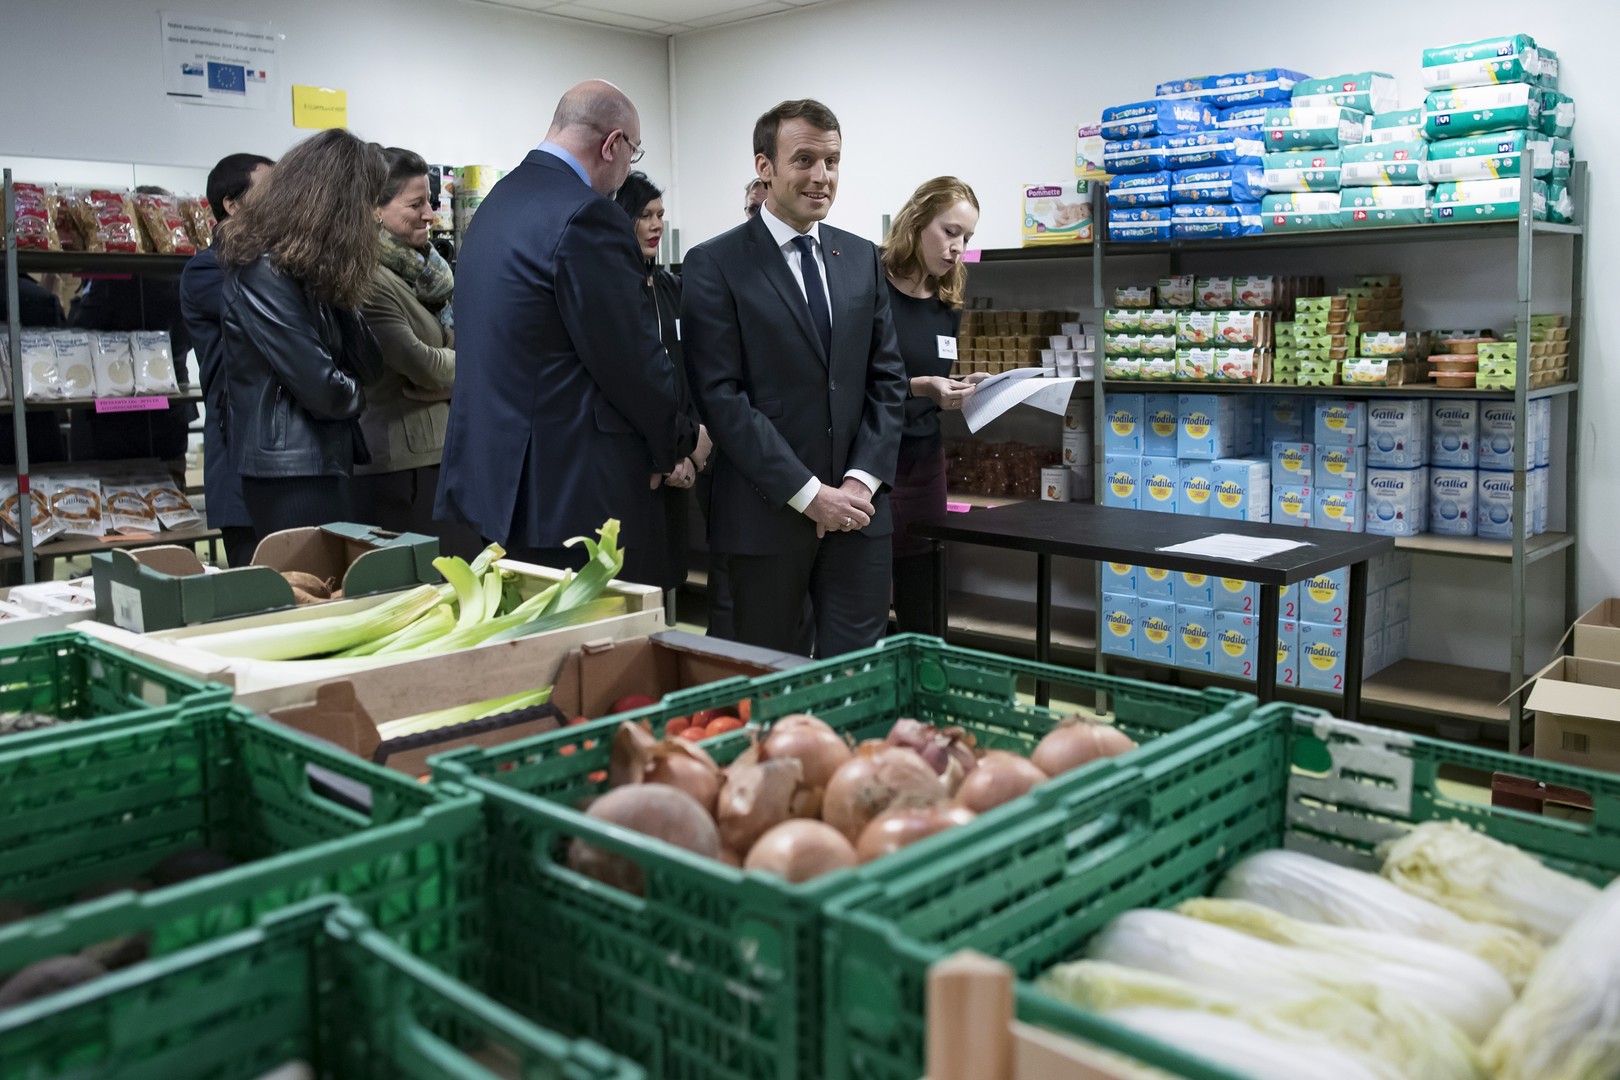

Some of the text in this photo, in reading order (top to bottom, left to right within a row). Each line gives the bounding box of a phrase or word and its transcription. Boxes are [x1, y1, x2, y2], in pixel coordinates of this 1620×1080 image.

[1078, 180, 1086, 189] 2
[1027, 189, 1061, 197] Pommette
[1107, 413, 1138, 424] modilac
[1148, 413, 1178, 424] modila
[1321, 409, 1351, 419] modilac
[1371, 407, 1405, 420] Gallia
[1435, 407, 1471, 420] Gallia
[1181, 415, 1215, 426] modilac
[1133, 435, 1139, 450] 1
[1207, 438, 1215, 454] 1
[1278, 451, 1306, 461] modilac
[1321, 453, 1350, 463] modilac
[1107, 475, 1138, 486] modilac
[1145, 478, 1177, 488] modilac
[1183, 480, 1211, 491] modila
[1370, 476, 1405, 489] Gallia
[1434, 476, 1468, 489] Gallia
[1213, 484, 1247, 495] modilac
[1277, 494, 1305, 504] modilac
[1320, 497, 1349, 508] modilac
[1170, 501, 1177, 513] 1
[1239, 508, 1246, 520] 1
[1130, 575, 1136, 590] 1
[1167, 581, 1173, 596] 1
[1304, 578, 1340, 591] modilac
[1205, 587, 1212, 602] 1
[1243, 596, 1252, 612] 2
[1285, 602, 1295, 617] 2
[1105, 613, 1136, 626] modilac
[1333, 607, 1342, 623] 2
[1141, 619, 1172, 632] modilac
[1180, 625, 1211, 639] modilac
[1129, 637, 1135, 652] 1
[1217, 633, 1251, 646] modilac
[1166, 644, 1172, 658] 1
[1204, 650, 1211, 665] 1
[1304, 645, 1340, 658] modilac
[1243, 661, 1252, 676] 2
[1284, 668, 1293, 684] 2
[1333, 674, 1343, 690] 2
